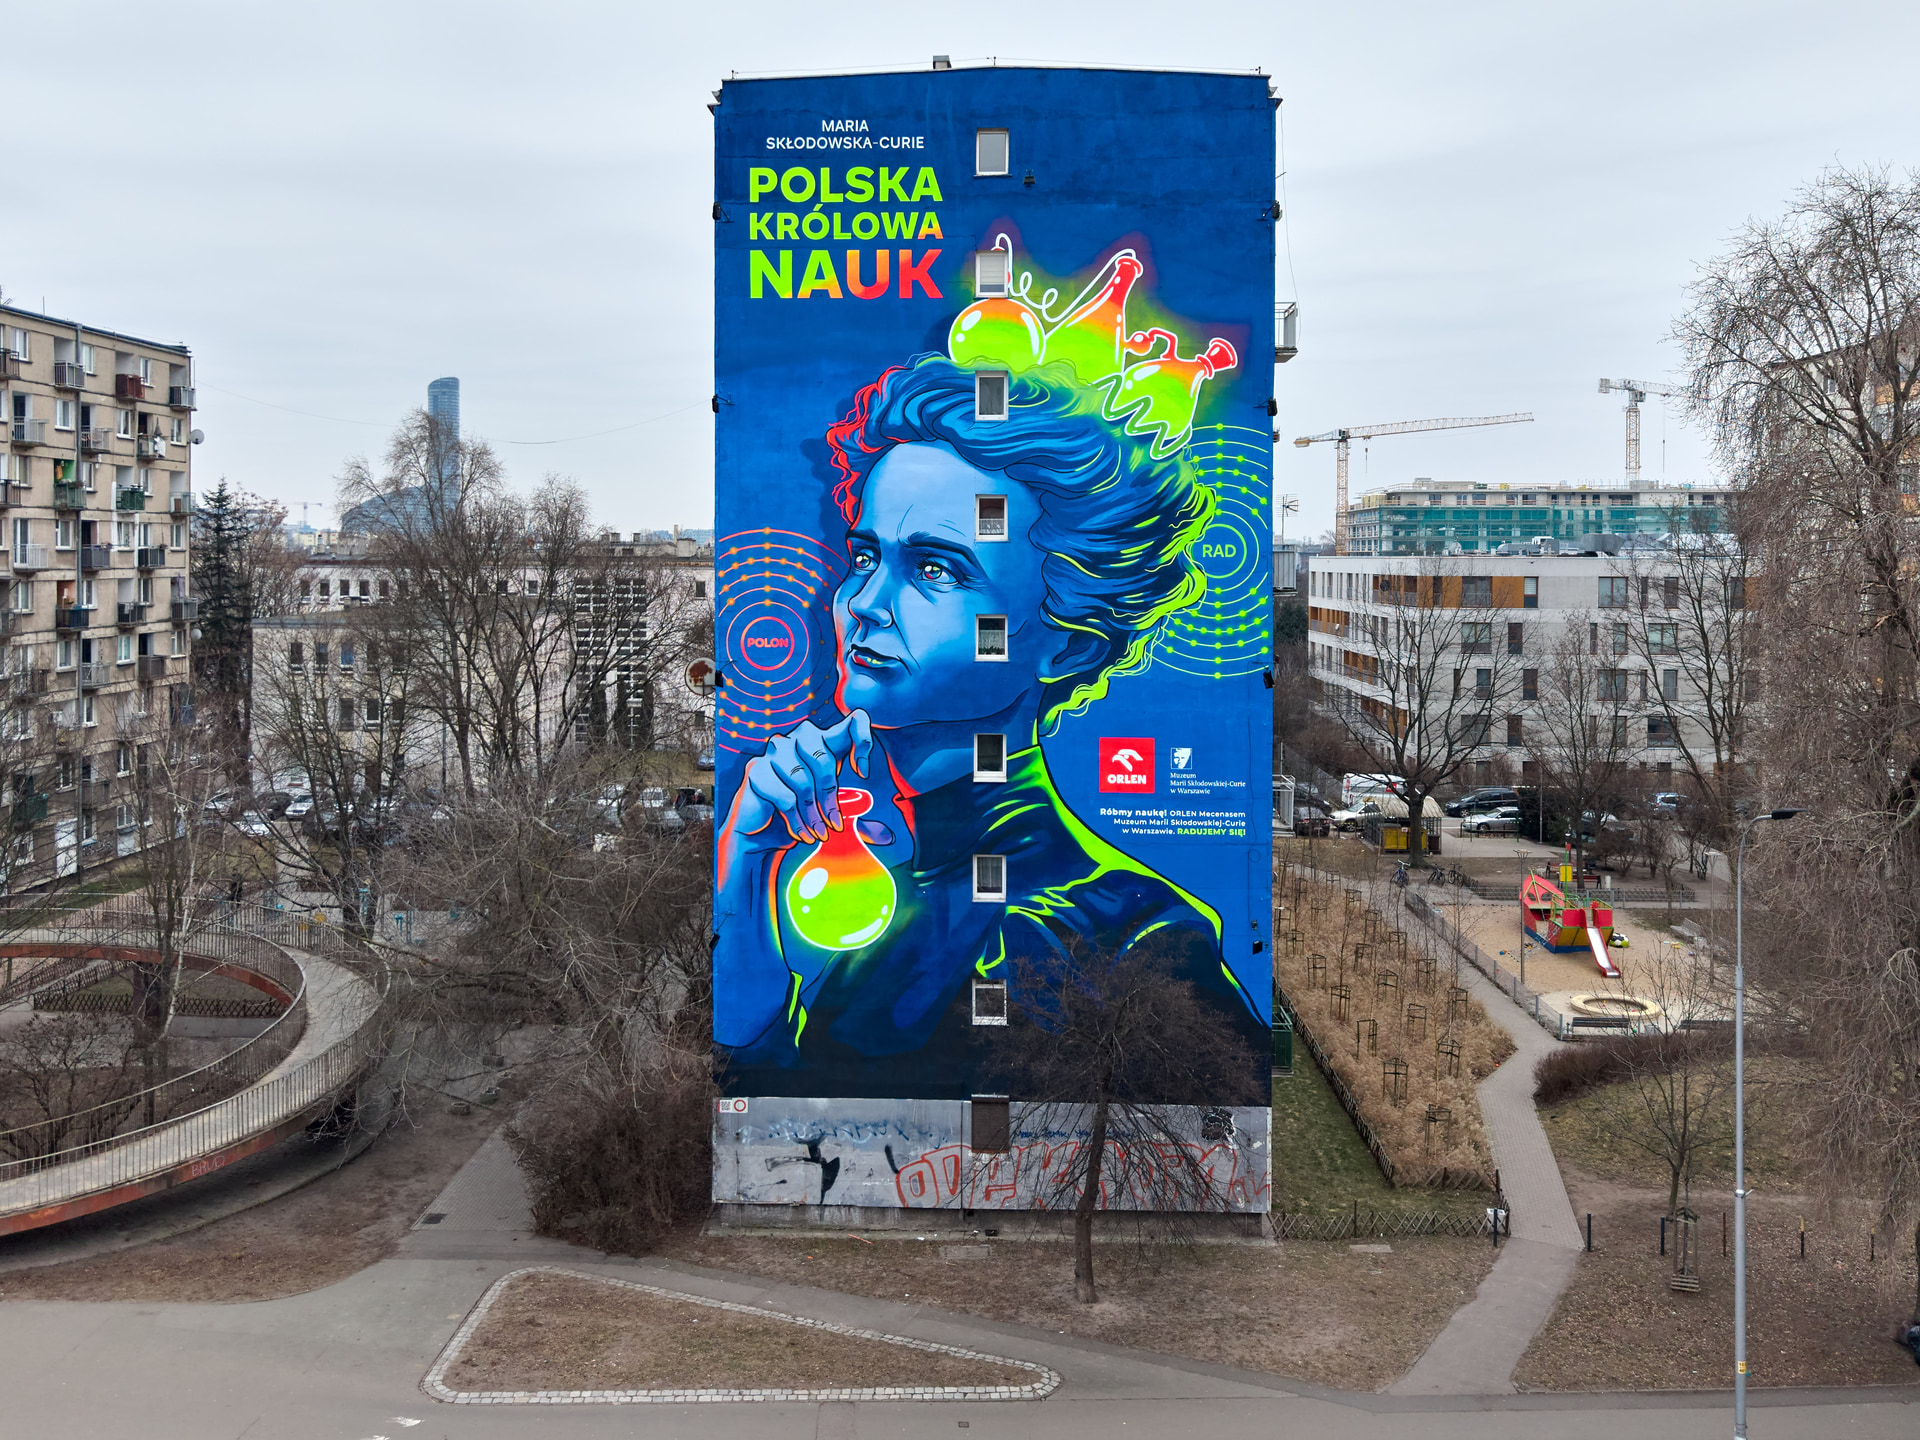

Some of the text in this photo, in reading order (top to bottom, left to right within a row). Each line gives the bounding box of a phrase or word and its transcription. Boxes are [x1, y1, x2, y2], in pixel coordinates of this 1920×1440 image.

[821, 119, 869, 132] MARIA
[766, 136, 924, 149] SKŁODOWSKA-CURIE
[750, 166, 943, 202] POLSKA
[750, 203, 943, 240] KRÓLOWA
[750, 249, 943, 299] NAUK
[1202, 544, 1236, 557] RAD
[747, 638, 788, 647] POLON
[1107, 774, 1146, 784] ORLEN
[1100, 807, 1133, 817] Róbmy
[1135, 808, 1168, 818] naukę!
[1170, 819, 1246, 828] Skłodowskiej-Curie
[1177, 828, 1227, 836] RADUJEMY
[1228, 828, 1246, 837] SIĘ!
